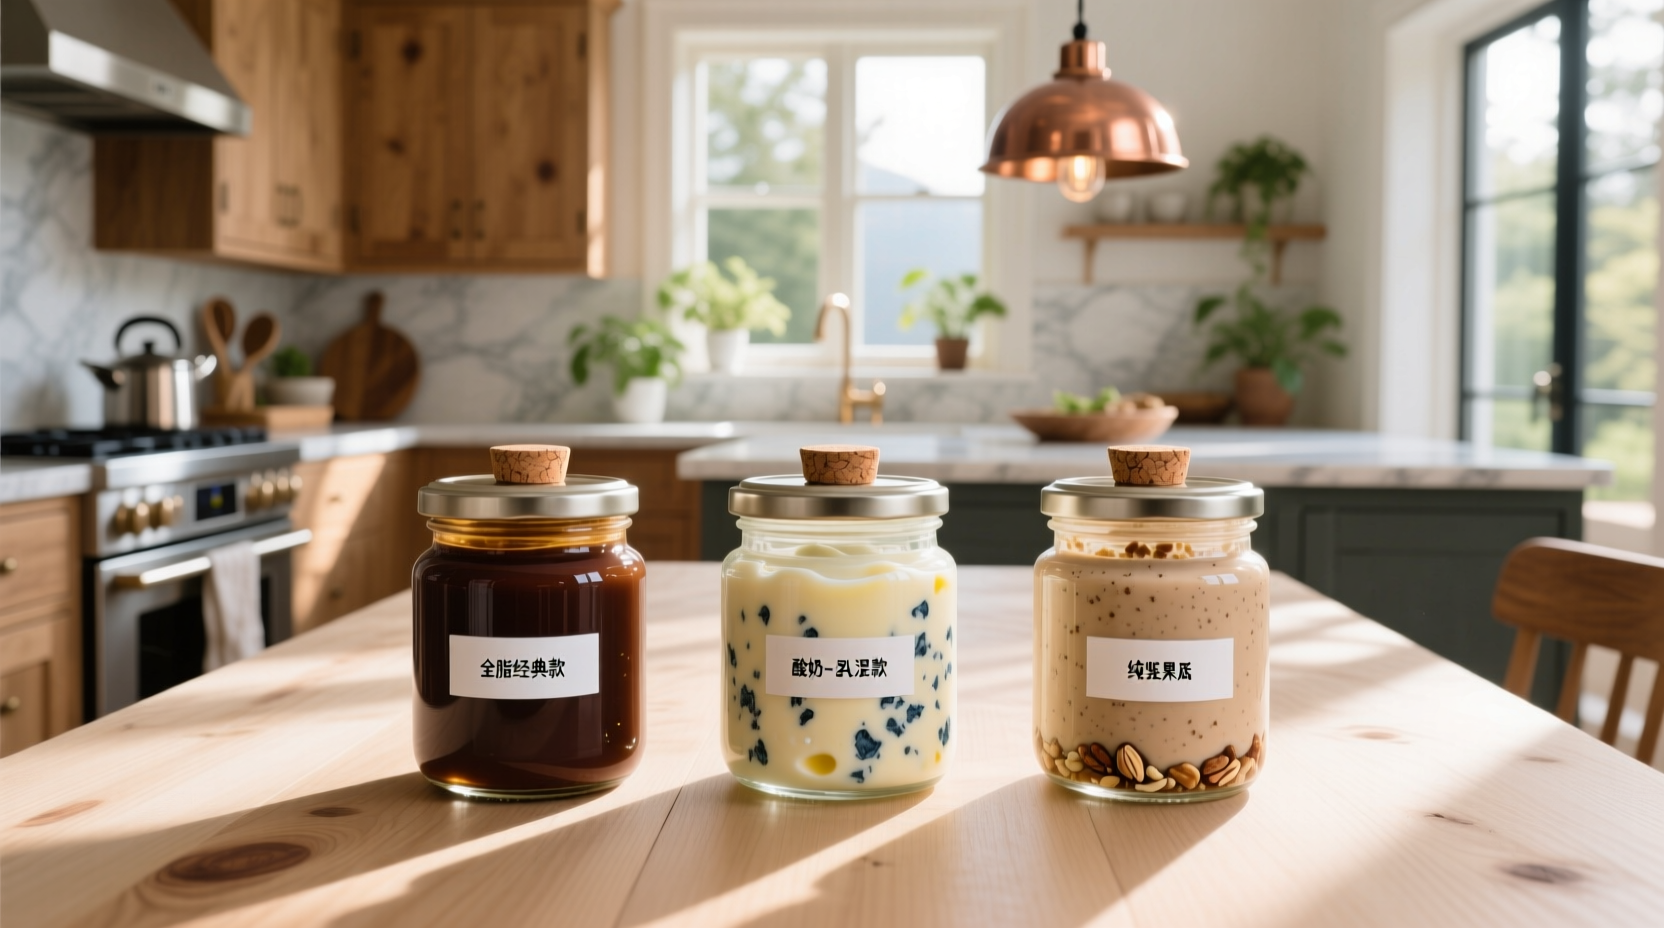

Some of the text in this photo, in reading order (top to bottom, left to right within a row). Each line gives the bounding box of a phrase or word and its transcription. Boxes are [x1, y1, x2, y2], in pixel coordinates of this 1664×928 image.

[480, 657, 566, 679] 全脂经典款
